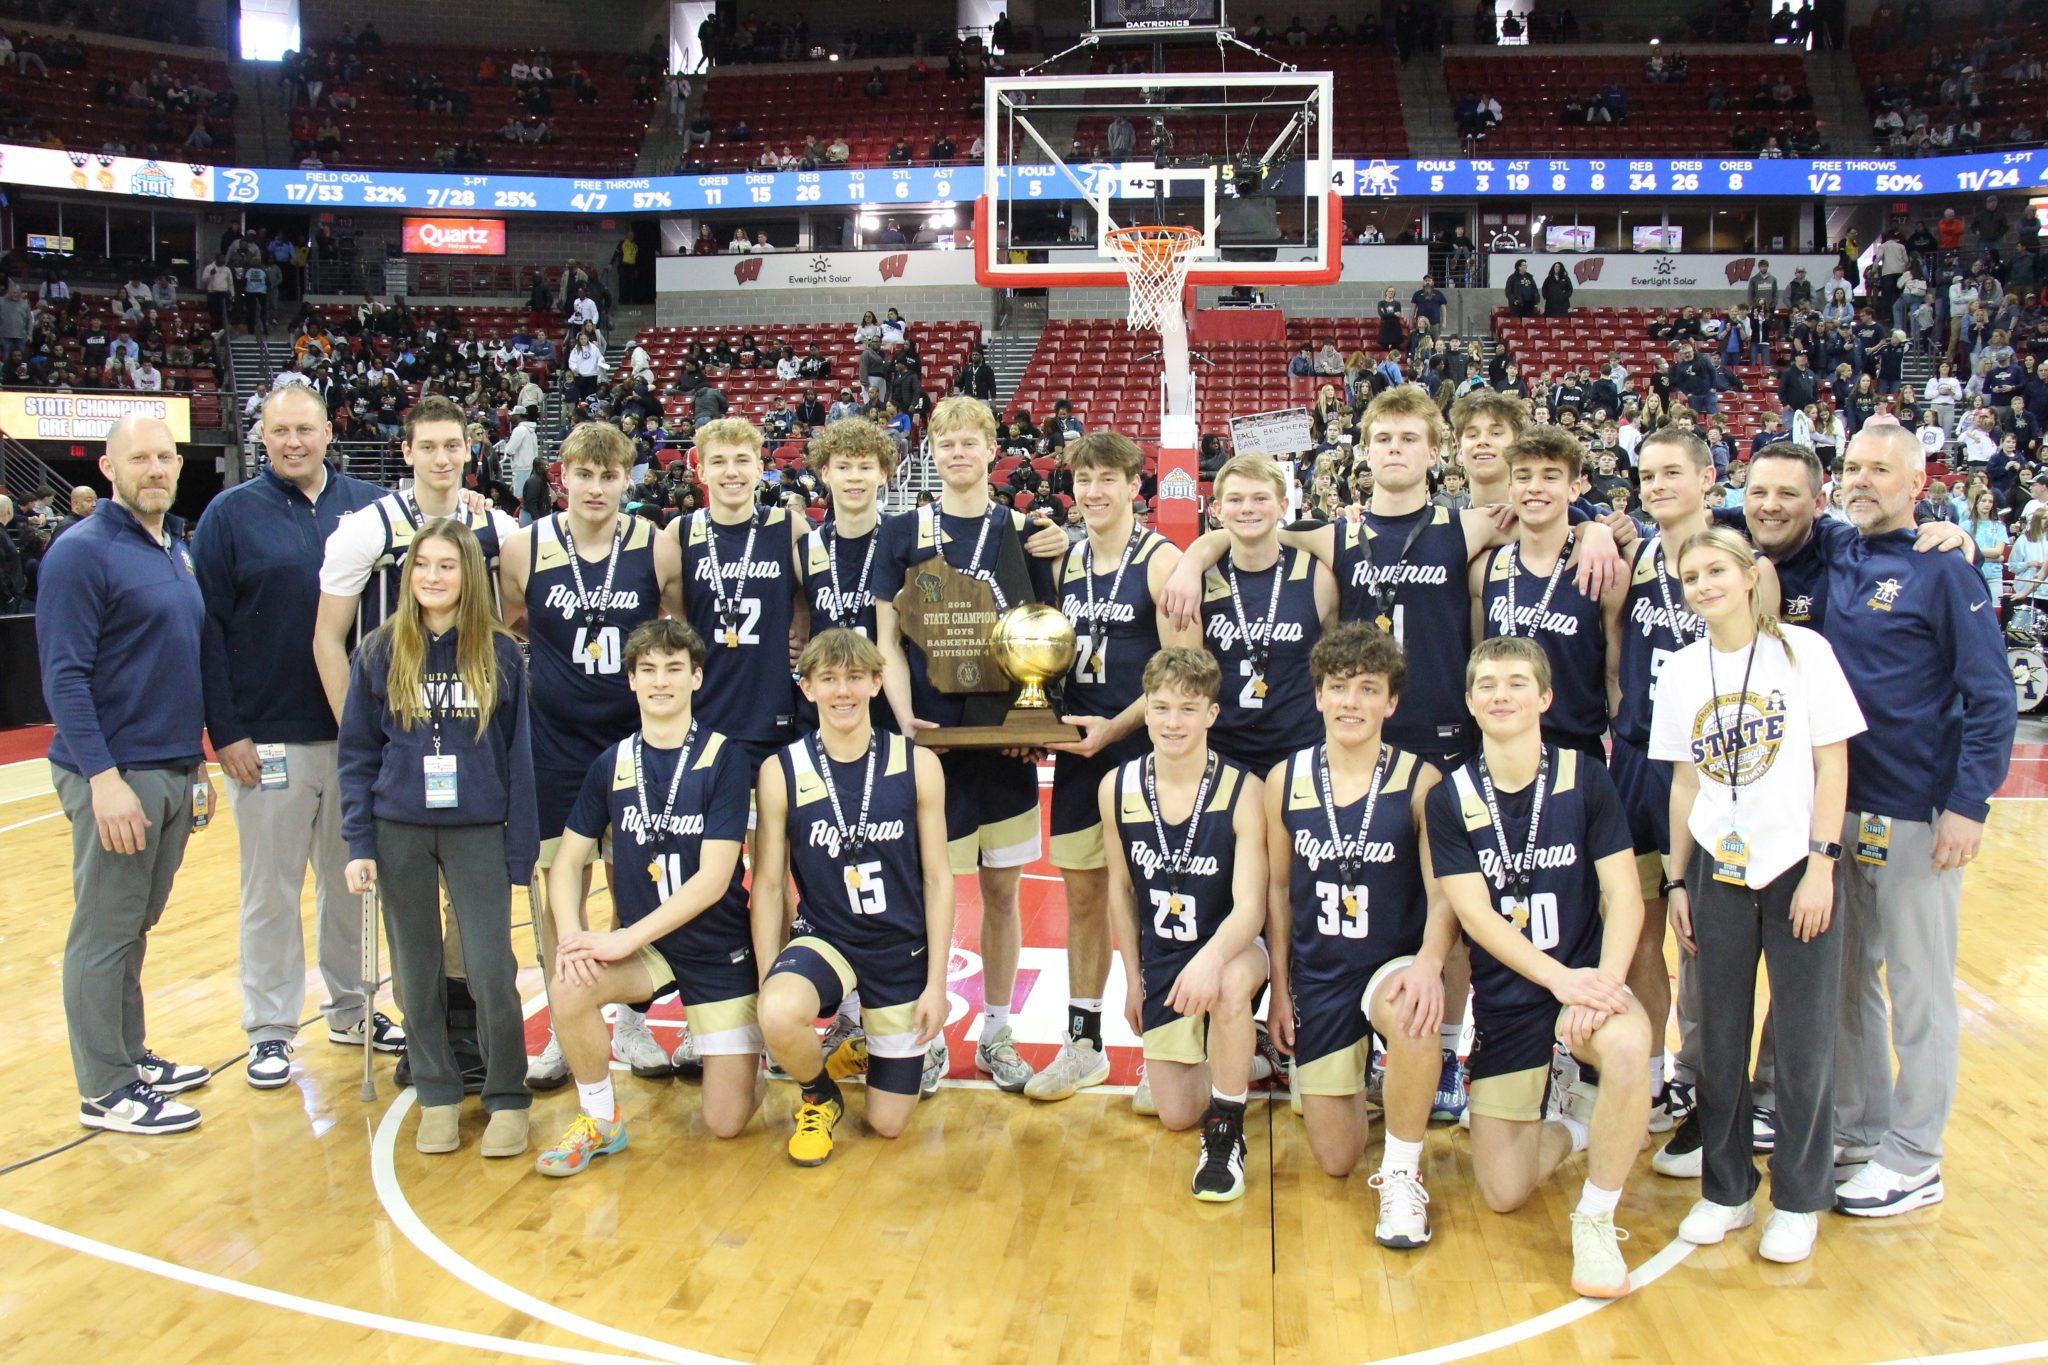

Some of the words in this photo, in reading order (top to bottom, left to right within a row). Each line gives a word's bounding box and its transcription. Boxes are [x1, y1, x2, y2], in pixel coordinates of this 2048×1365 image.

[1126, 20, 1190, 28] DAKTRONICS
[1417, 161, 1456, 172] FOULS
[1471, 161, 1495, 172] TOL
[1508, 161, 1530, 172] AST
[1549, 161, 1570, 172] STL
[1589, 161, 1605, 172] TO
[1630, 161, 1653, 172] REB
[1671, 161, 1703, 171] DREB
[1719, 161, 1752, 171] OREB
[1812, 161, 1843, 172] FREE
[1846, 161, 1897, 172] THROWS
[2003, 152, 2032, 164] 3-PT
[306, 172, 338, 183] FIELD
[341, 174, 373, 184] GOAL
[463, 177, 488, 186] 3-PT
[698, 176, 728, 186] OREB
[745, 175, 775, 185] DREB
[798, 172, 820, 183] REB
[850, 171, 865, 181] TO
[892, 170, 912, 180] STL
[933, 169, 954, 179] AST
[1018, 166, 1056, 177] FOULS
[1957, 168, 2020, 191] 11/24
[131, 175, 174, 198] STATE
[574, 181, 601, 190] FREE
[605, 179, 650, 190] THROWS
[848, 182, 865, 199] 11
[895, 182, 909, 198] 6
[937, 180, 951, 197] 9
[1029, 180, 1042, 196] 5
[1430, 176, 1444, 192] 5
[1476, 175, 1490, 192] 3
[1506, 174, 1530, 191] 19
[1552, 175, 1566, 191] 8
[1590, 174, 1605, 191] 8
[1629, 174, 1656, 191] 34
[1672, 174, 1699, 191] 26
[1729, 174, 1743, 191] 8
[1808, 174, 1841, 194] 1/2
[1876, 175, 1923, 192] 50%
[285, 183, 343, 203] 17/53
[363, 186, 406, 203] 32%
[426, 188, 475, 208] 7/28
[494, 191, 537, 208] 25%
[570, 193, 608, 212] 4/7
[633, 192, 672, 208] 57%
[705, 189, 722, 205] 11
[750, 186, 772, 203] 15
[796, 185, 821, 201] 26
[419, 223, 488, 247] Quartz
[789, 275, 827, 285] Everlight
[829, 274, 852, 283] Solar
[1632, 277, 1671, 287] Everlight
[1674, 277, 1697, 286] Solar
[25, 396, 73, 416] STATE
[76, 399, 166, 419] CHAMPIONS
[38, 418, 70, 437] ARE
[1263, 423, 1308, 436] BROTHERS
[1161, 482, 1196, 499] STATE
[566, 535, 575, 556] STATE
[603, 535, 621, 590] CHAMPIONSHIPS
[1657, 560, 1666, 584] STATE
[570, 556, 590, 611] CHAMPIONSHIPS
[1102, 599, 1114, 622] STATE
[1110, 547, 1133, 600] CHAMPIONSHIPS
[1230, 572, 1239, 595] STATE
[1351, 560, 1447, 596] Aquinas
[545, 584, 640, 620] Aqias
[600, 589, 611, 611] STATE
[1267, 566, 1283, 623] CHAMPIONSHIPS
[1528, 614, 1542, 638] STATE
[1537, 558, 1565, 615] CHAMPIONSHIPS
[923, 613, 950, 625] STATE
[952, 612, 996, 625] CHAMPION
[1062, 594, 1135, 628] Aqias
[1661, 583, 1682, 644] CHAMPIONSHIPS
[946, 628, 974, 636] BOYS
[1233, 594, 1253, 650] CHAMPIONSHIPS
[1263, 623, 1273, 646] STATE
[572, 626, 621, 674] 40
[933, 649, 980, 658] DIVISION
[1075, 635, 1108, 683] 21
[1239, 659, 1264, 708] 2
[1698, 701, 1723, 724] CROSE
[1725, 694, 1758, 704] AQAS
[1691, 715, 1784, 764] STATE
[661, 805, 673, 829] STATE
[668, 746, 690, 805] CHAMPIONSHIPS
[819, 754, 831, 778] STATE
[826, 777, 849, 838] CHAMPIONSHIPS
[857, 812, 867, 837] STATE
[865, 752, 876, 812] CHAMPIONSHIPS
[1483, 776, 1495, 801] STATE
[635, 767, 652, 829] CHAMPIONSHIPS
[1528, 774, 1546, 842] CHAMPIONSHIPS
[1182, 838, 1193, 862] STATE
[1188, 778, 1209, 839] CHAMPIONSHIPS
[1320, 767, 1330, 791] STATE
[1325, 791, 1344, 857] CHAMPIONSHIPS
[1356, 830, 1367, 856] STATE
[1362, 766, 1383, 831] CHAMPIONSHIPS
[621, 805, 704, 845] Aqnas
[1151, 800, 1171, 861] CHAMPIONSHIPS
[809, 819, 904, 858] Aqnas
[1488, 801, 1512, 870] CHAMPIONSHIPS
[1131, 840, 1219, 880] Aqias
[1523, 841, 1534, 870] STATE
[1478, 843, 1577, 890] Aqnas
[656, 853, 682, 905] 11
[844, 860, 887, 915] 15
[1149, 888, 1198, 942] 23
[1315, 881, 1369, 938] 33
